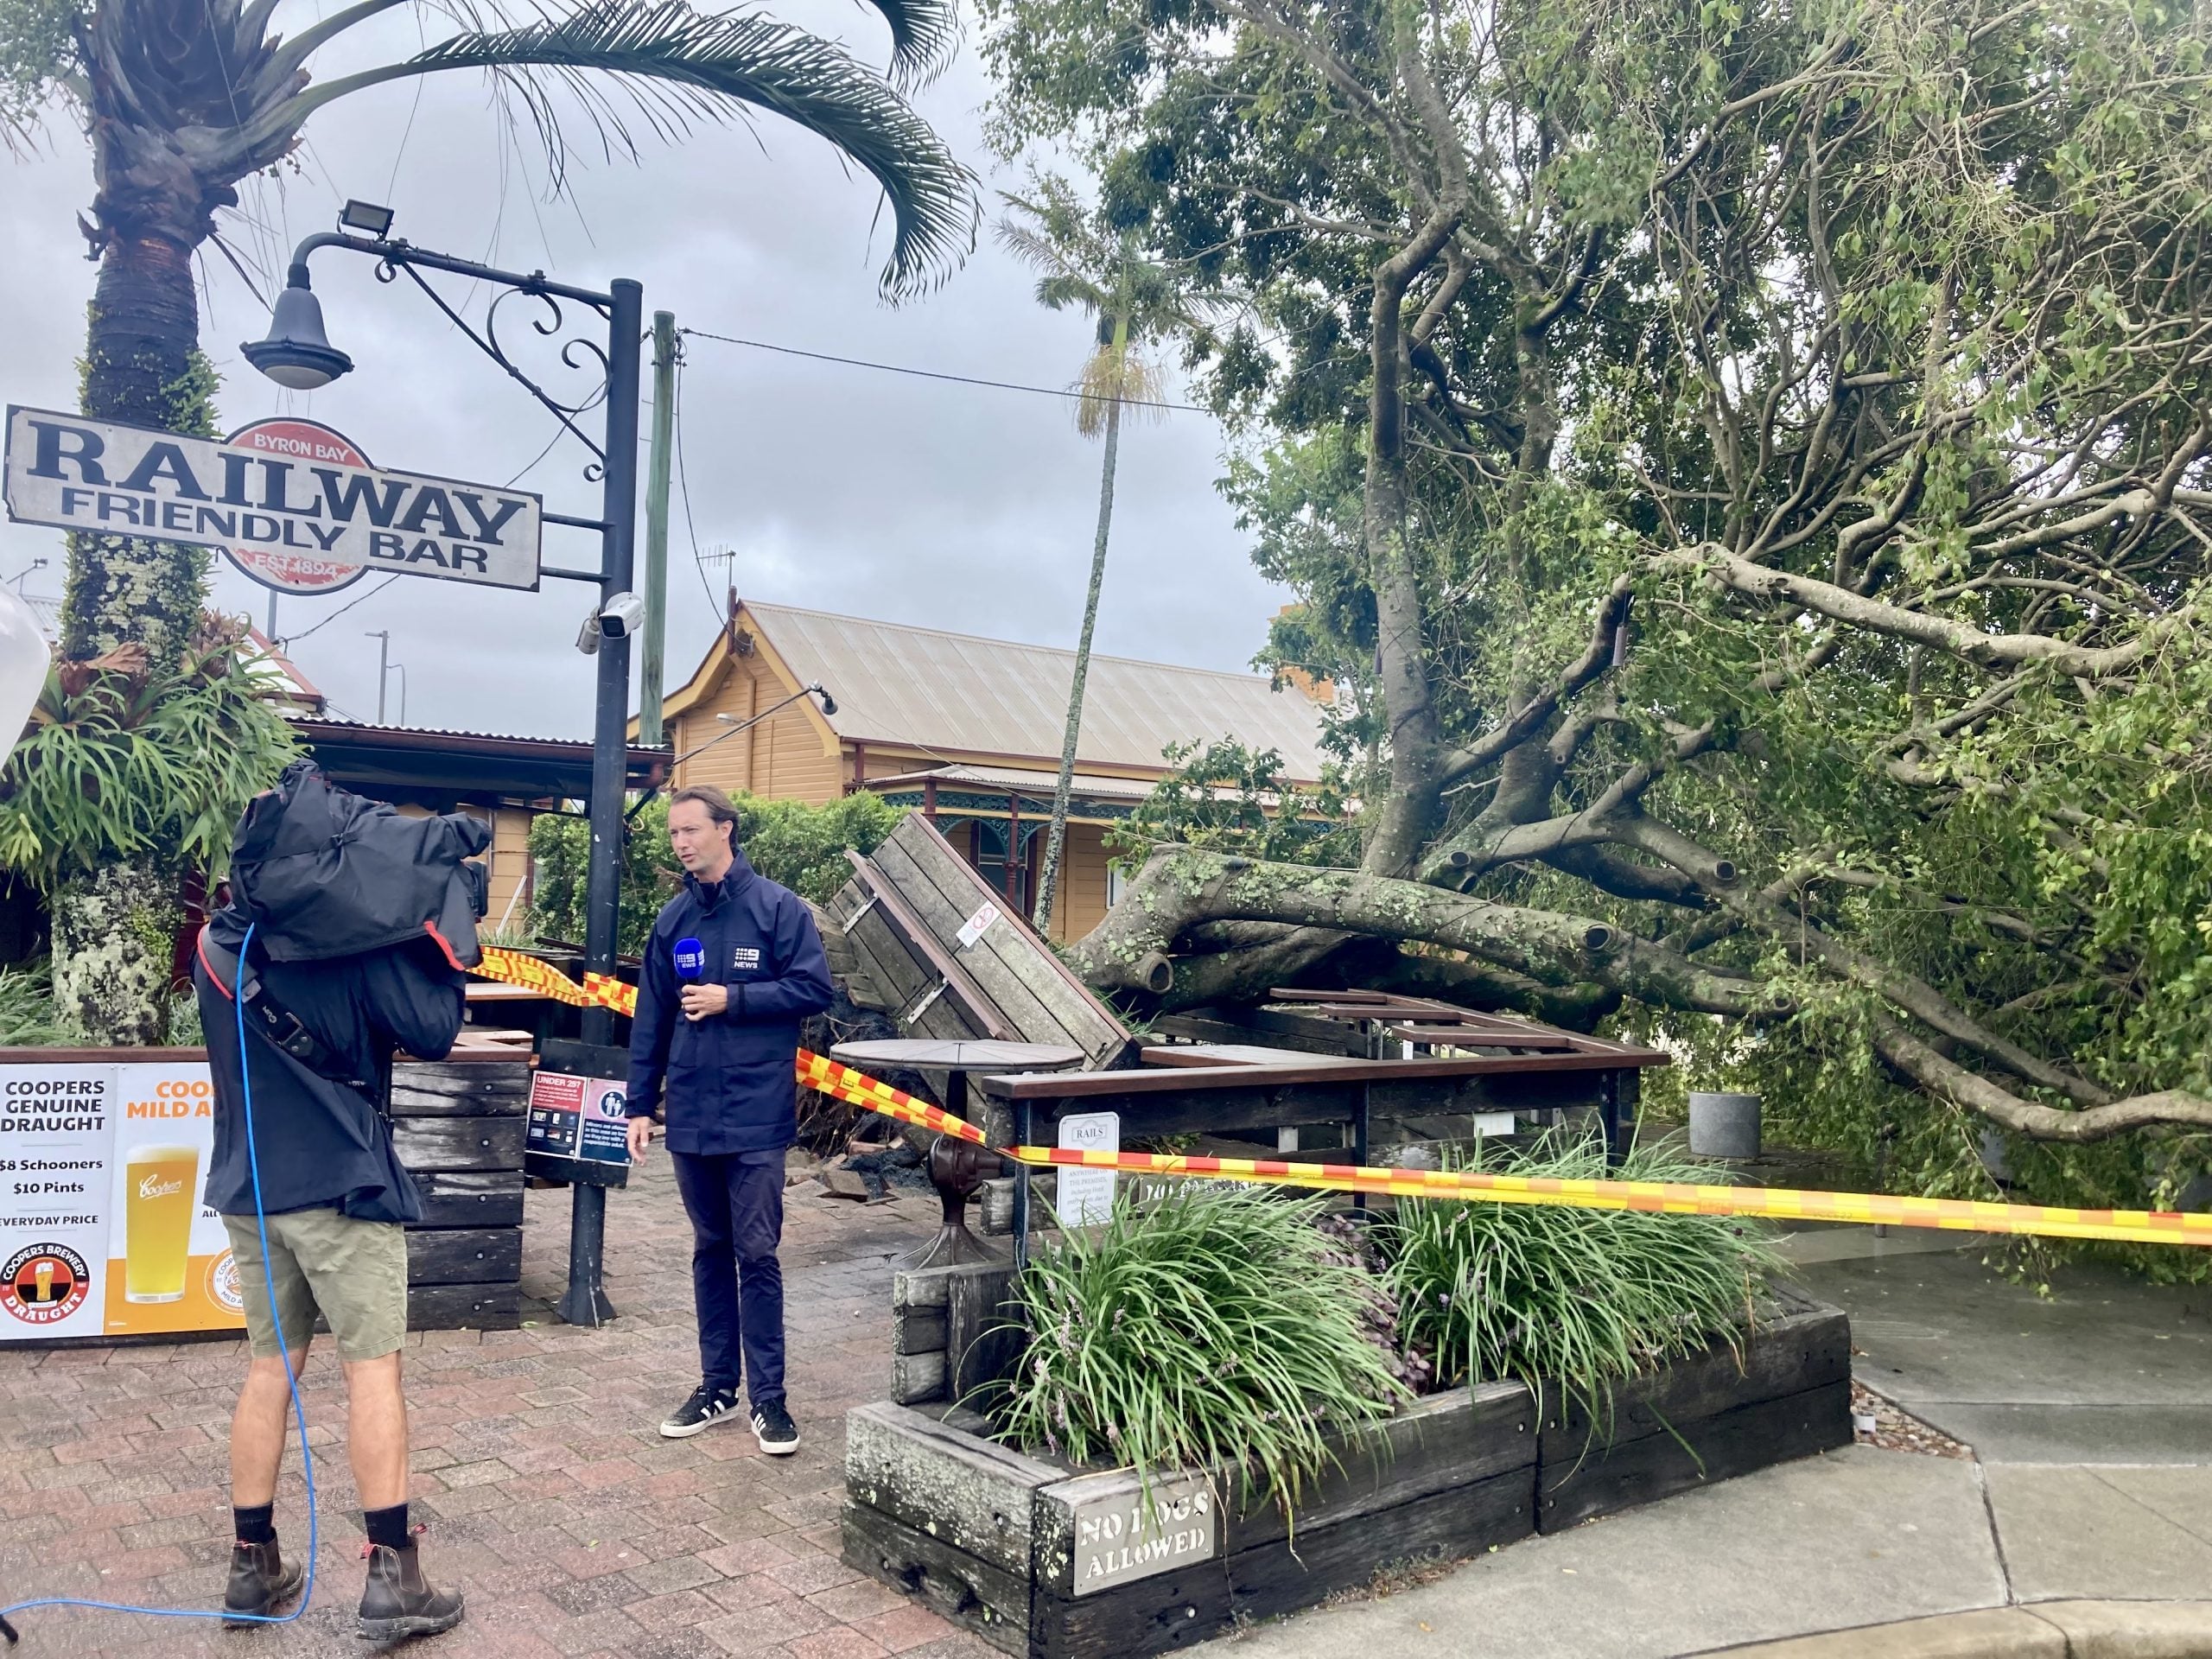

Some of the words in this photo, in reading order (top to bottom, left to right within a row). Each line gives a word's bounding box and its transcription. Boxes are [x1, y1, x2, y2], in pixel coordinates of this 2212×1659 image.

[254, 434, 311, 455] BYRON
[315, 444, 349, 461] BAY
[27, 420, 527, 545] RAILWAY
[61, 487, 346, 551] FRIENDLY
[369, 531, 489, 573] BAR
[5, 1081, 105, 1096] COOPERS
[537, 1076, 566, 1086] UNDER
[6, 1099, 102, 1113] GENUINE
[127, 1102, 189, 1118] MILD
[0, 1117, 105, 1132] DRAUGHT
[1077, 1128, 1103, 1140] RAILS
[0, 1160, 16, 1171] $8
[20, 1160, 103, 1171] Schooners
[14, 1182, 40, 1195] $10
[44, 1181, 84, 1193] Pints
[63, 1216, 99, 1224] PRICE
[3, 1246, 44, 1281] COOPERS
[47, 1245, 86, 1277] BREWERY
[219, 1257, 233, 1274] COOP
[5, 1293, 81, 1321] DRAUGHT
[1080, 1512, 1122, 1547] NO
[1086, 1528, 1205, 1580] ALLOWED
